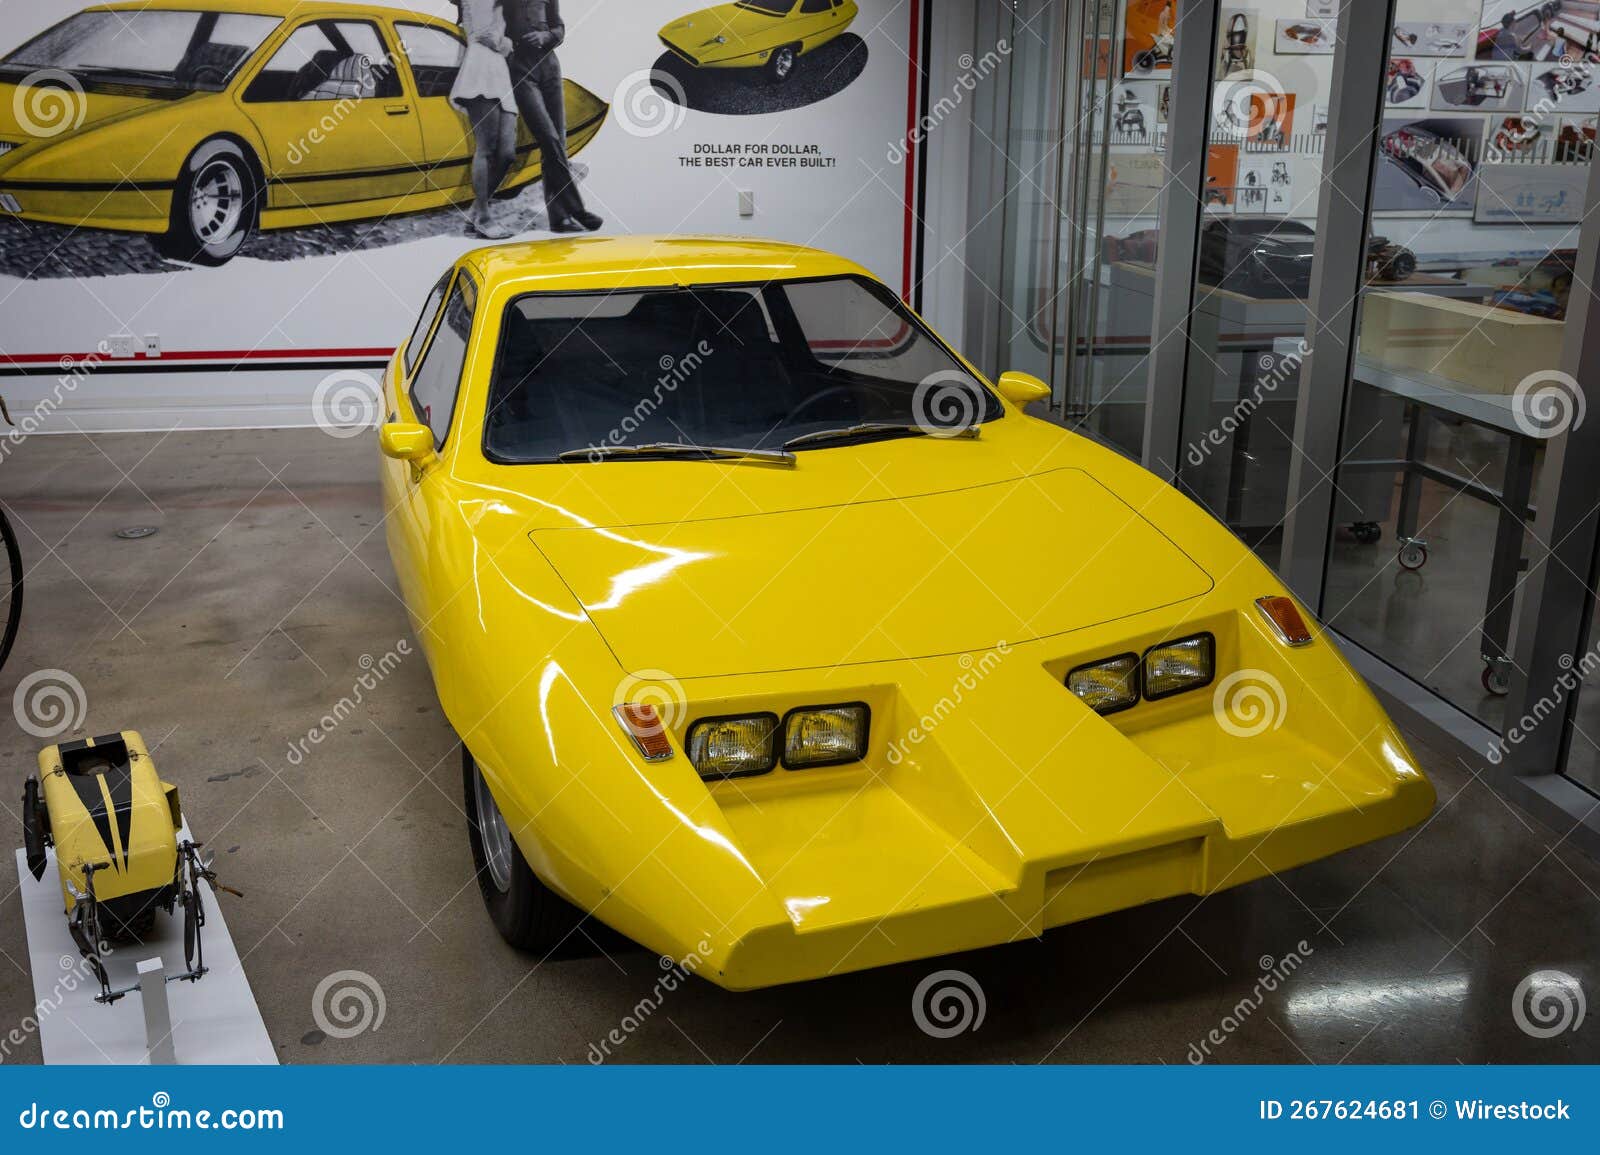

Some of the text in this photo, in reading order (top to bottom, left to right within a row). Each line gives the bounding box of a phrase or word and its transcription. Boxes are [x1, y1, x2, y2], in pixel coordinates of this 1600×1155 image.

[693, 144, 822, 157] DOLLAR FOR DOLLAR,
[679, 157, 836, 168] THE BEST CAR EVER BUILT!
